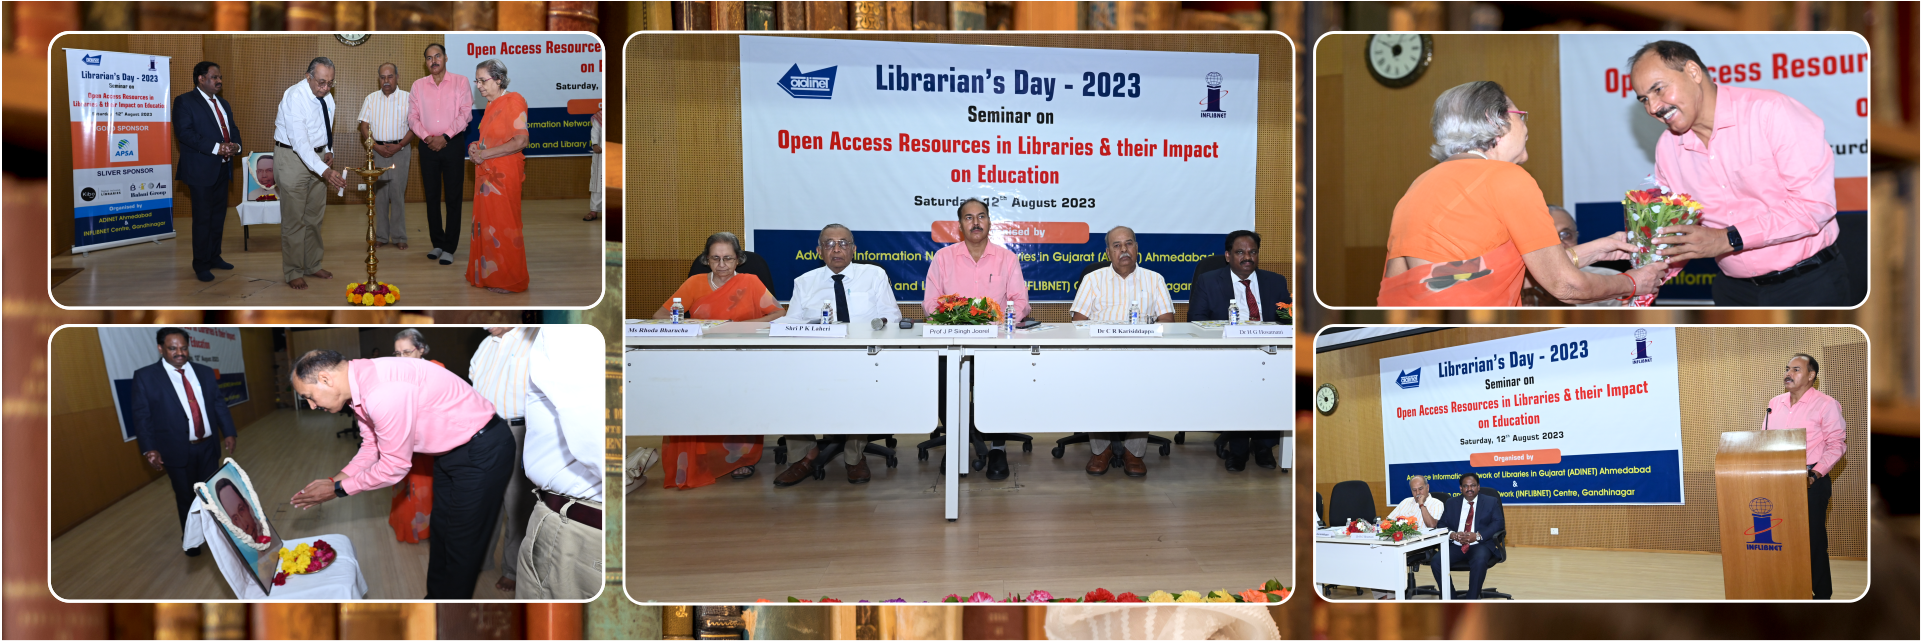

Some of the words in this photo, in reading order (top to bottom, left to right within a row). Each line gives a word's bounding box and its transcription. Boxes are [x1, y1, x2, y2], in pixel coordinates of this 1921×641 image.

[466, 42, 496, 58] Open
[500, 42, 542, 55] Access
[580, 62, 595, 73] on
[81, 71, 120, 80] Librarian's
[122, 73, 135, 82] Day
[141, 74, 159, 82] 2023
[1605, 68, 1634, 98] Op
[1772, 52, 1868, 80] Resour
[556, 82, 599, 90] Saturday,
[876, 64, 1006, 95] Librarian's
[1014, 68, 1056, 102] Day
[1082, 71, 1141, 99] 2023
[968, 106, 1032, 124] Seminar
[1036, 112, 1054, 125] on
[527, 120, 561, 128] ormation
[542, 140, 559, 148] and
[560, 140, 588, 149] Library
[778, 129, 823, 154] Open
[830, 130, 892, 151] Access
[899, 132, 990, 154] Resources
[996, 135, 1012, 154] in
[1018, 136, 1094, 156] Libraries
[1099, 137, 1112, 157] &
[1117, 138, 1158, 157] their
[1163, 139, 1219, 162] Impact
[950, 168, 972, 183] on
[978, 164, 1060, 184] Education
[914, 195, 968, 206] Saturd
[1012, 197, 1057, 210] August
[1062, 198, 1096, 208] 2023
[98, 215, 118, 223] ADINET
[118, 212, 152, 220] Ahmedabad
[83, 228, 110, 236] INFLIBNET
[132, 221, 166, 230] Gandhinagar
[1034, 227, 1046, 238] by
[854, 250, 922, 261] Information
[1040, 252, 1050, 262] in
[1052, 252, 1095, 264] Gujarat
[894, 280, 918, 291] and
[1026, 281, 1070, 293] FLIBNET)
[1438, 354, 1505, 378] Librarian's
[1510, 350, 1534, 370] Day
[1550, 340, 1589, 362] 2023
[1485, 377, 1521, 390] Seminar
[1524, 376, 1534, 385] on
[1396, 406, 1417, 420] Open
[1419, 404, 1449, 416] Access
[1451, 400, 1499, 414] Resources
[1502, 396, 1511, 408] in
[1514, 391, 1560, 407] Libraries
[1563, 388, 1572, 402] &
[1575, 385, 1603, 400] their
[1607, 381, 1648, 399] Impact
[1478, 417, 1490, 429] on
[1493, 412, 1540, 428] Education
[1460, 437, 1494, 445] Saturday,
[1512, 434, 1540, 442] August
[1542, 431, 1564, 440] 2023
[1494, 454, 1524, 462] Organised
[1502, 470, 1529, 478] Libraries
[1538, 469, 1566, 478] Gujarat
[1567, 468, 1598, 477] (ADINET)
[1599, 466, 1652, 475] Ahmedabad
[1516, 490, 1551, 498] (INFLIBNET)
[1553, 489, 1580, 498] Centre,
[1581, 488, 1636, 498] Gandhinagar
